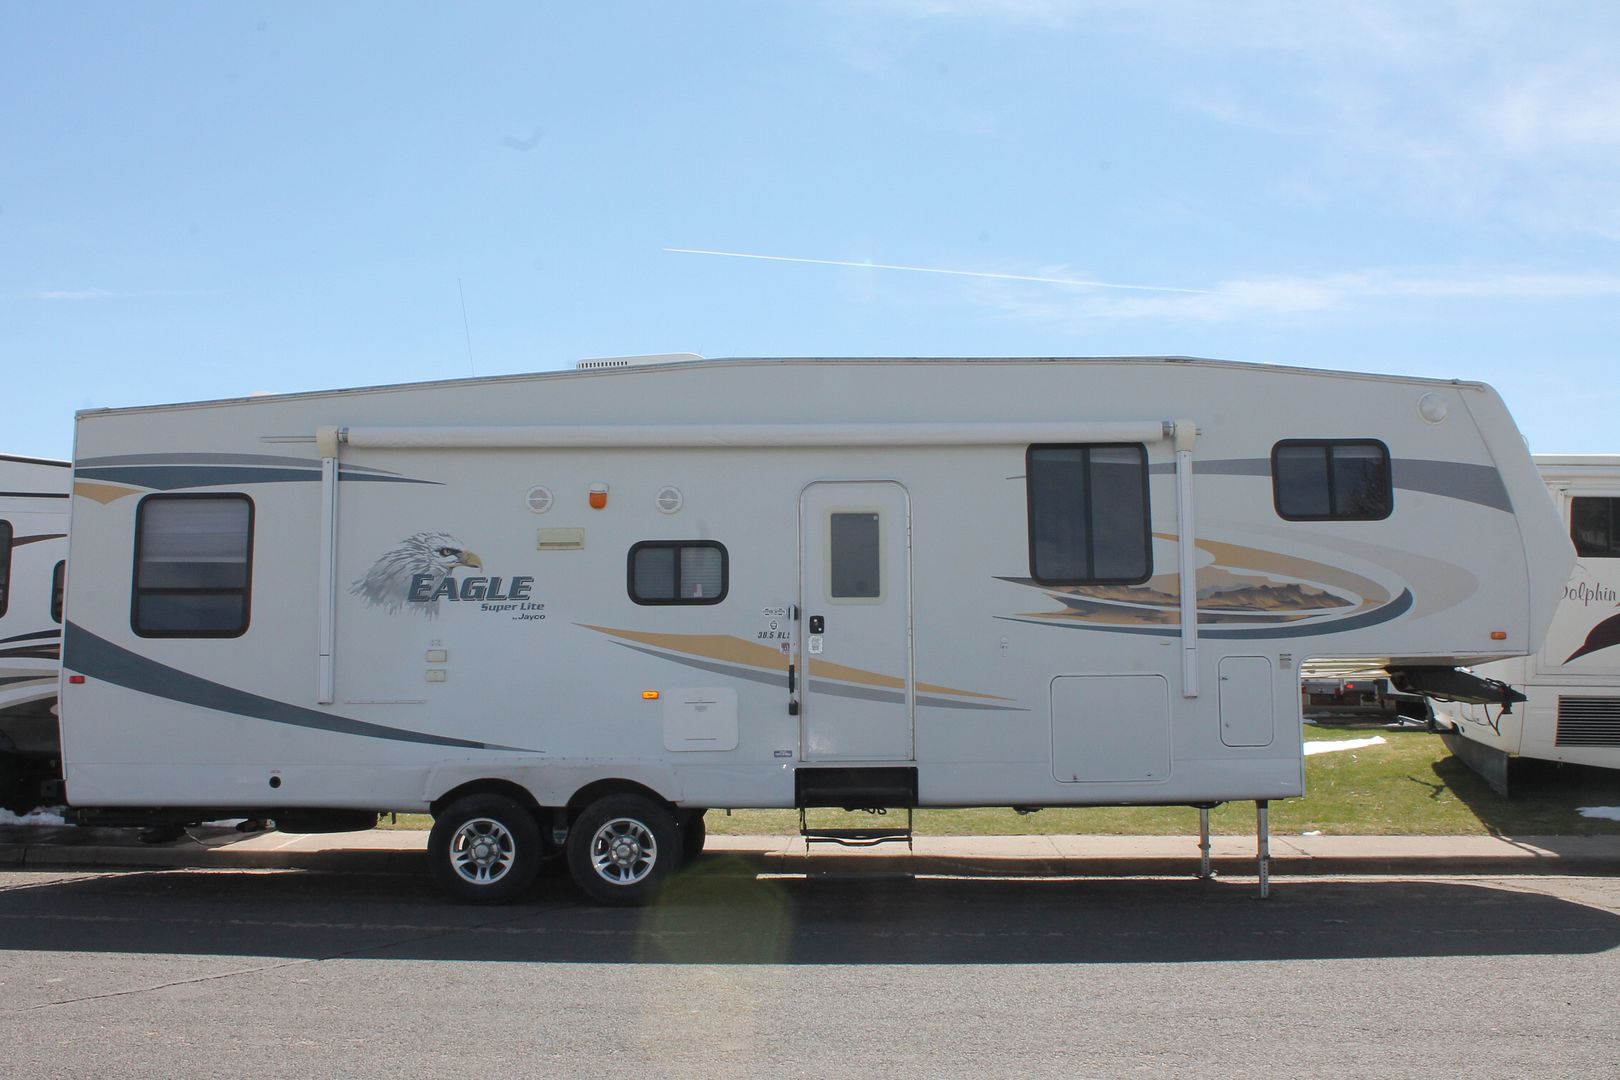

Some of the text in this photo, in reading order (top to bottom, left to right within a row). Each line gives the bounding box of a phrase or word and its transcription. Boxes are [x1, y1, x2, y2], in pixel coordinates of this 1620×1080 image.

[408, 574, 534, 602] EAGLE
[481, 603, 517, 612] Super
[518, 613, 546, 621] Jayco
